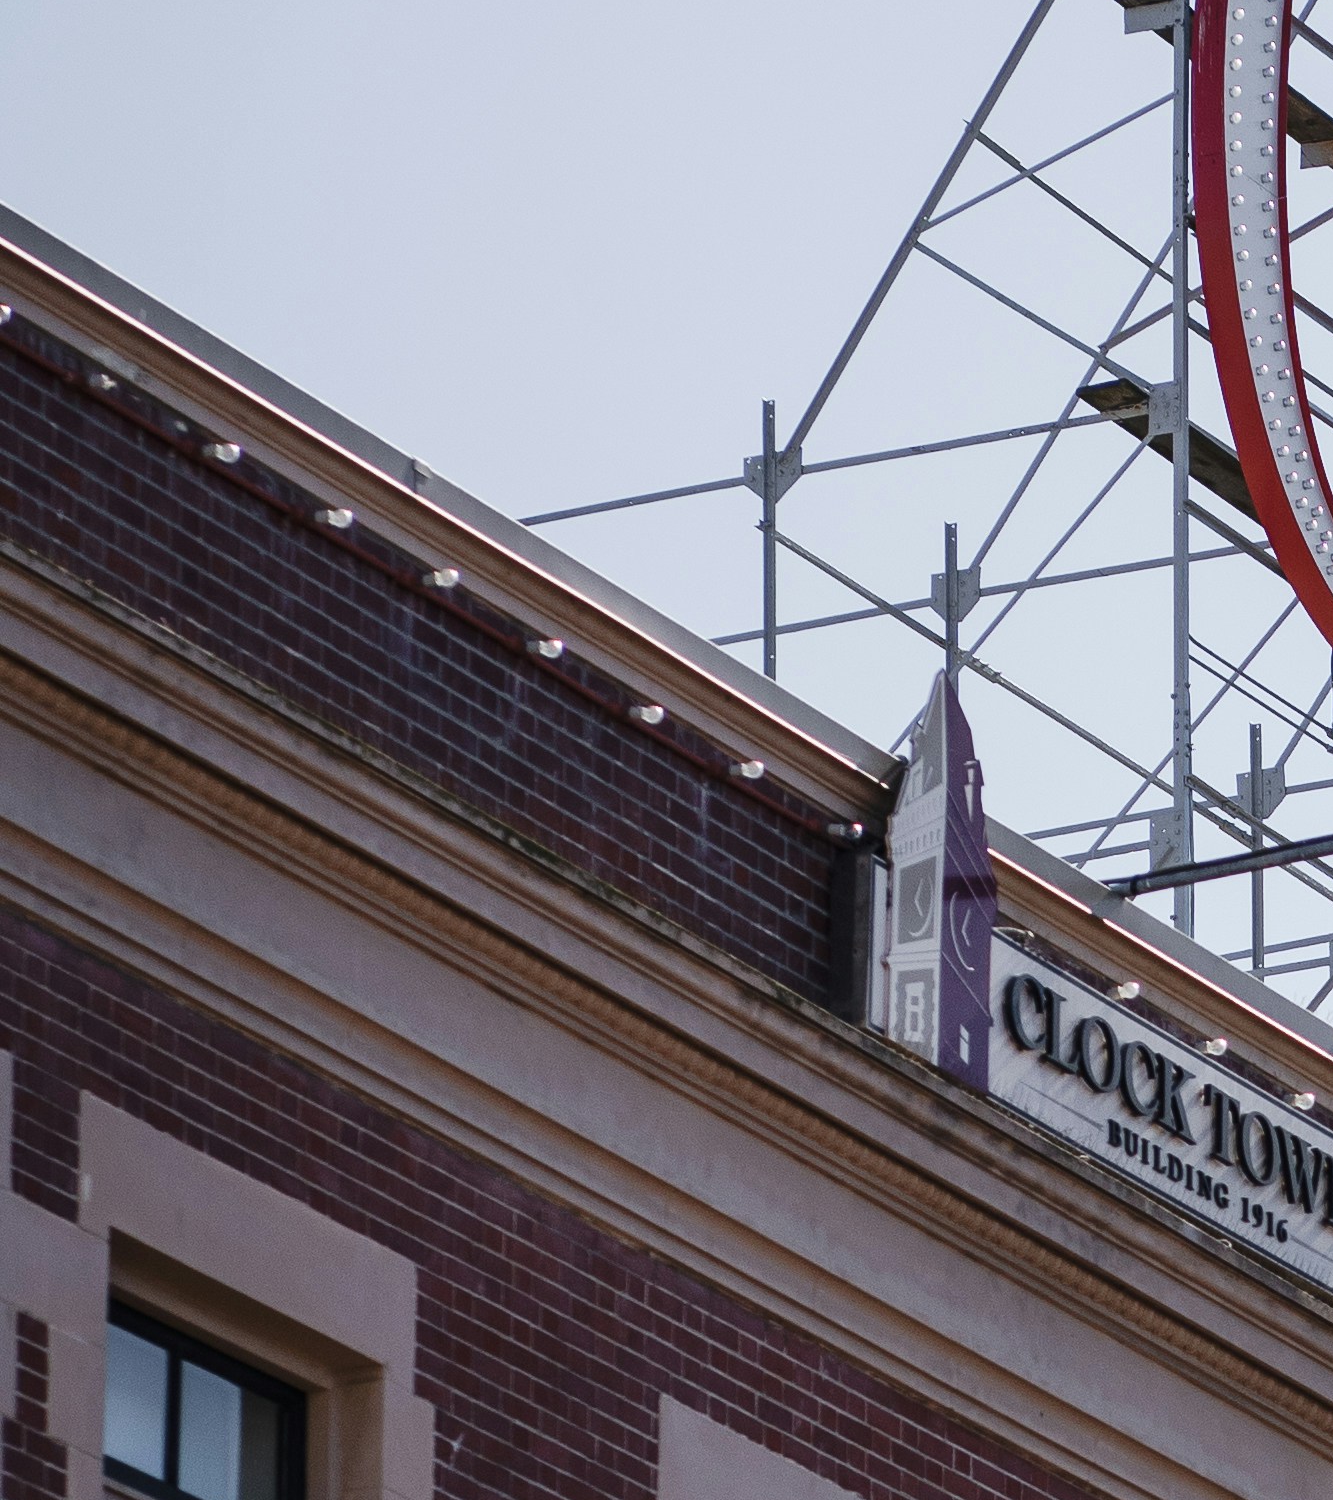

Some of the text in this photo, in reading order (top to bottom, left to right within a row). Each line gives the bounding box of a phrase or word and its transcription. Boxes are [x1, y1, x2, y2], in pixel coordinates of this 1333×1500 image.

[1002, 973, 1196, 1145] CLOCK
[1107, 1118, 1289, 1243] BUILDING 1916
